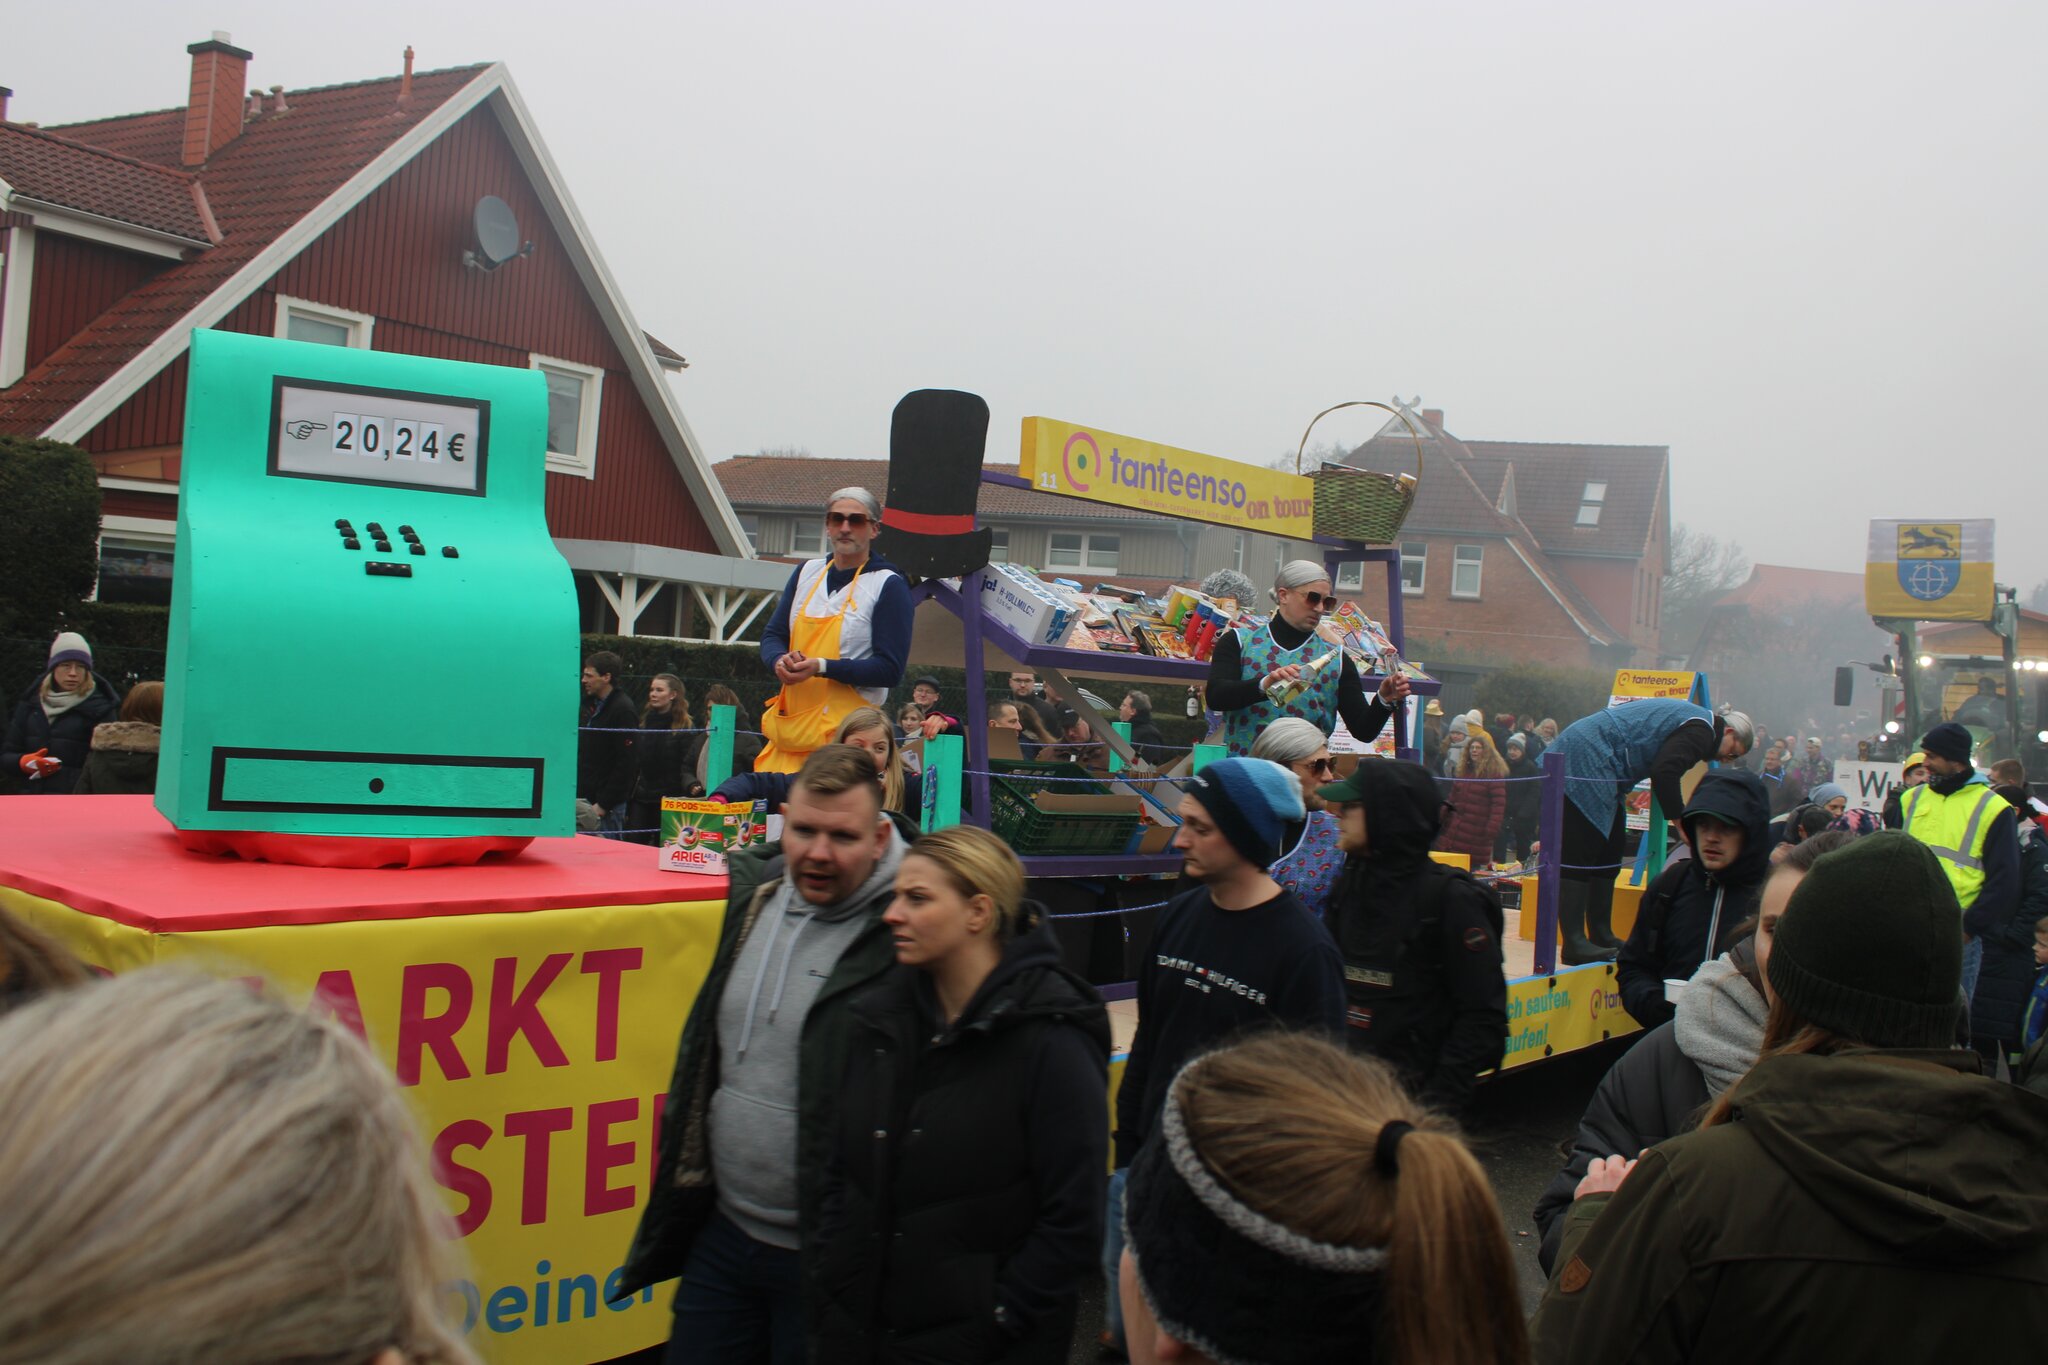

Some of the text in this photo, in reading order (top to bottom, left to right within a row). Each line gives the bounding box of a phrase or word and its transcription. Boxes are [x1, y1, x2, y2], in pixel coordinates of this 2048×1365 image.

[335, 420, 466, 462] 20,24€
[1040, 471, 1058, 490] 11
[1109, 447, 1247, 509] tanteenso
[1246, 499, 1270, 520] on
[1273, 495, 1312, 518] tour
[980, 575, 998, 592] ja!
[1632, 675, 1678, 686] tanteenso
[664, 800, 674, 809] 76
[676, 801, 699, 811] PODS
[671, 850, 708, 864] ARIEL
[1505, 996, 1523, 1020] ch
[1604, 991, 1622, 1011] tan
[234, 946, 644, 1088] ARKT
[1504, 1022, 1549, 1055] aufen!
[429, 1093, 668, 1241] STE
[434, 1259, 654, 1336] Deine
